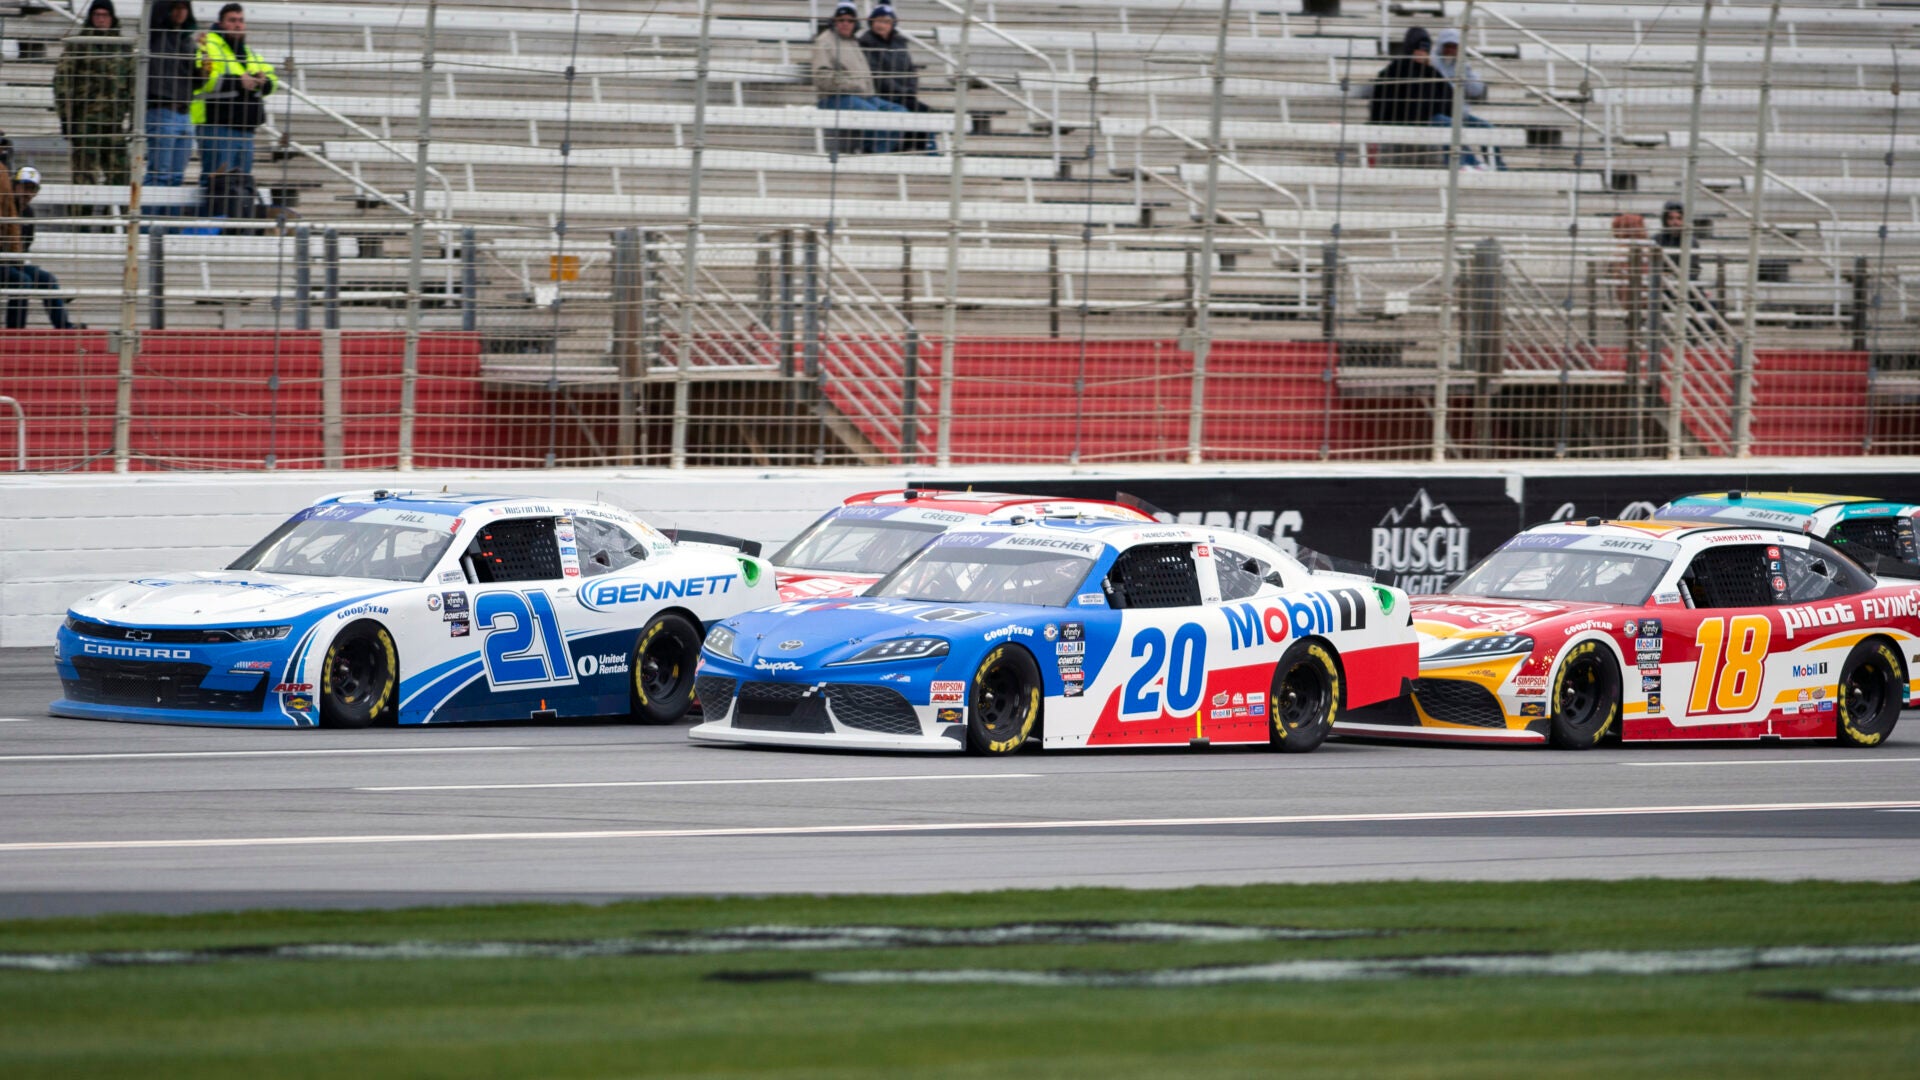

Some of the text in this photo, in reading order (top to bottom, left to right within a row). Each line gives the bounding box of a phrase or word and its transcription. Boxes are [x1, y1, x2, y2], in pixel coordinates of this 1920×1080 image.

[395, 513, 425, 524] HILL
[920, 511, 966, 523] CREED
[1746, 510, 1795, 523] SMITH
[1739, 533, 1763, 542] SMITH
[1006, 536, 1096, 553] NEMECHEK
[1371, 526, 1469, 573] BUSCH
[1600, 539, 1654, 552] SMITH
[596, 574, 738, 606] BENNETT
[337, 603, 390, 620] GOODYEAR
[1861, 594, 1917, 620] FLYING
[444, 611, 469, 620] COMETIC
[1220, 588, 1367, 651] Mobil 1
[984, 624, 1034, 642] GOODYEAR
[1564, 619, 1613, 636] GOODYEAR
[473, 588, 580, 693] 21
[1058, 642, 1076, 652] Mobil
[1636, 639, 1653, 649] Mobil
[84, 643, 191, 660] CAMARO
[1636, 652, 1661, 661] COMETIC
[599, 653, 626, 665] United
[1058, 656, 1084, 665] COMETIC
[1687, 615, 1771, 716] 18
[599, 663, 629, 675] Rentals
[754, 658, 803, 677] Supra
[1121, 621, 1208, 716] 20
[1792, 661, 1828, 678] Mobil 1
[272, 683, 314, 693] ARP
[933, 682, 964, 691] SIMPSON
[1517, 677, 1546, 686] SIMPSON
